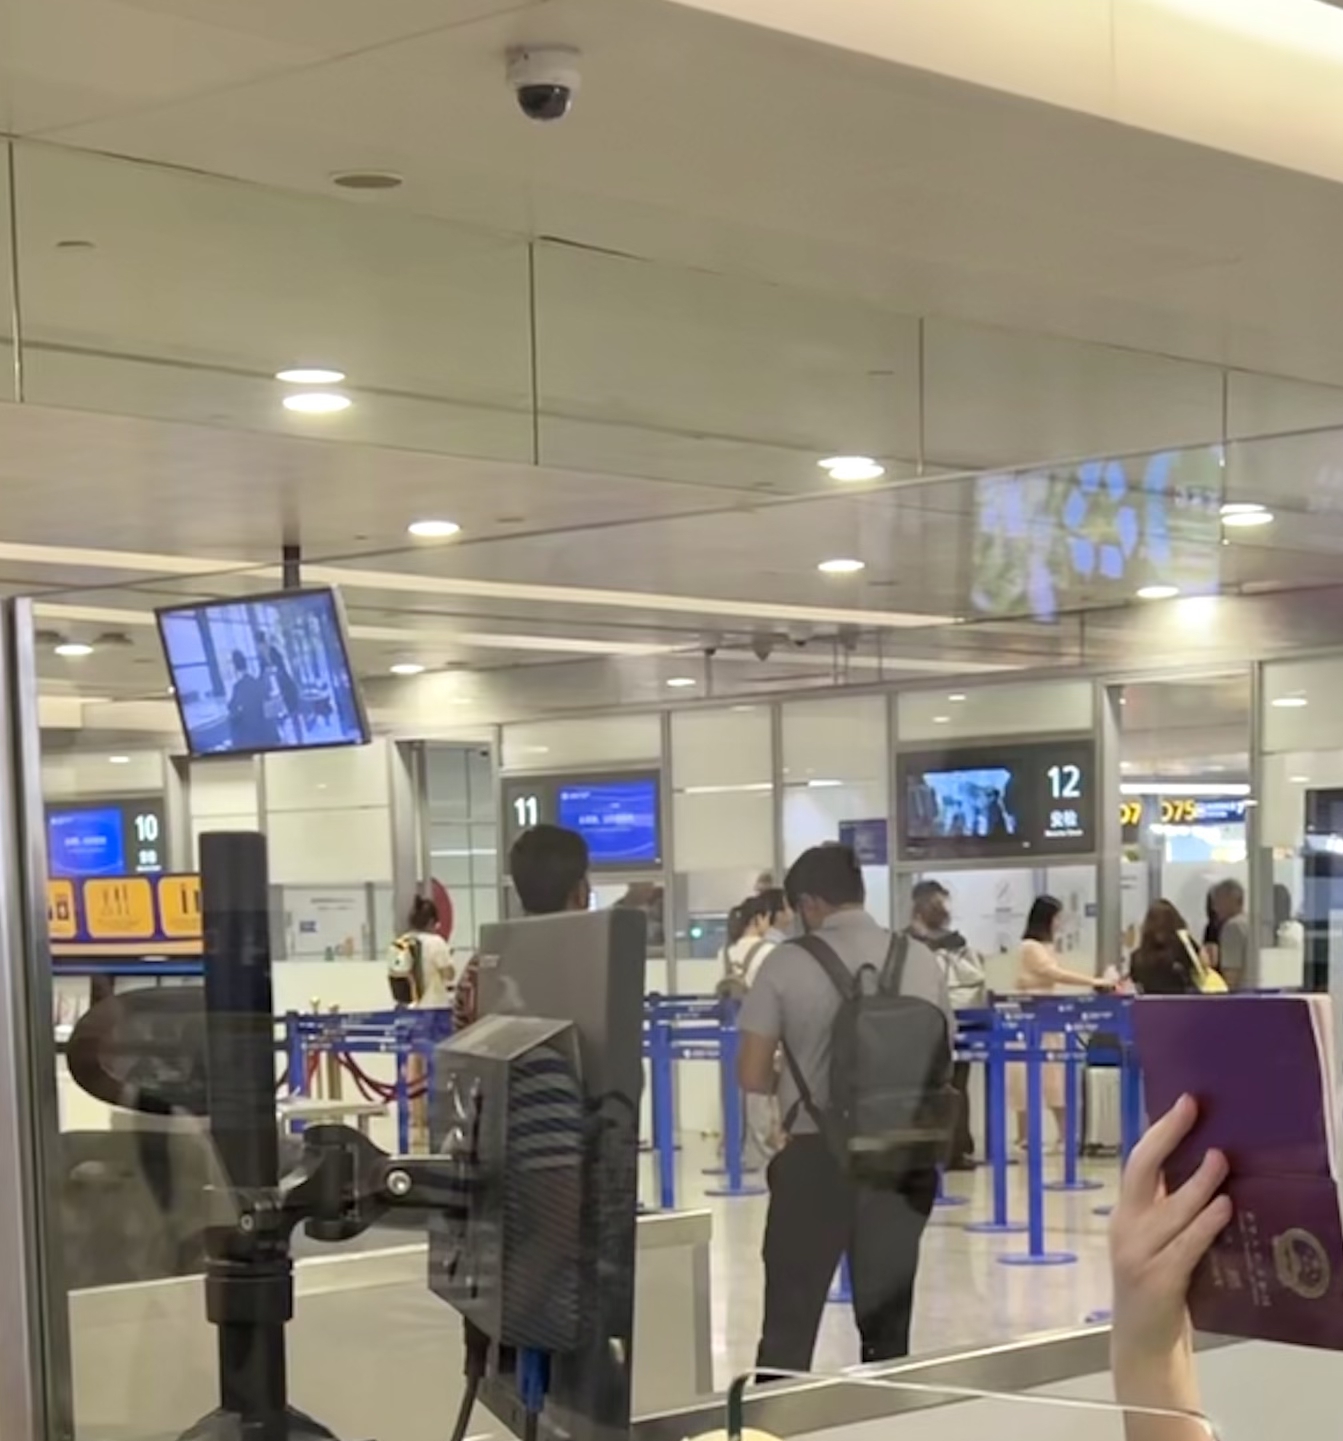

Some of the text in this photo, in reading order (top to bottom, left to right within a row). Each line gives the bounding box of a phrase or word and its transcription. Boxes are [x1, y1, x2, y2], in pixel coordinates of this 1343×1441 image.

[1047, 765, 1081, 798] 12
[514, 796, 537, 826] 11
[134, 814, 158, 841] 10
